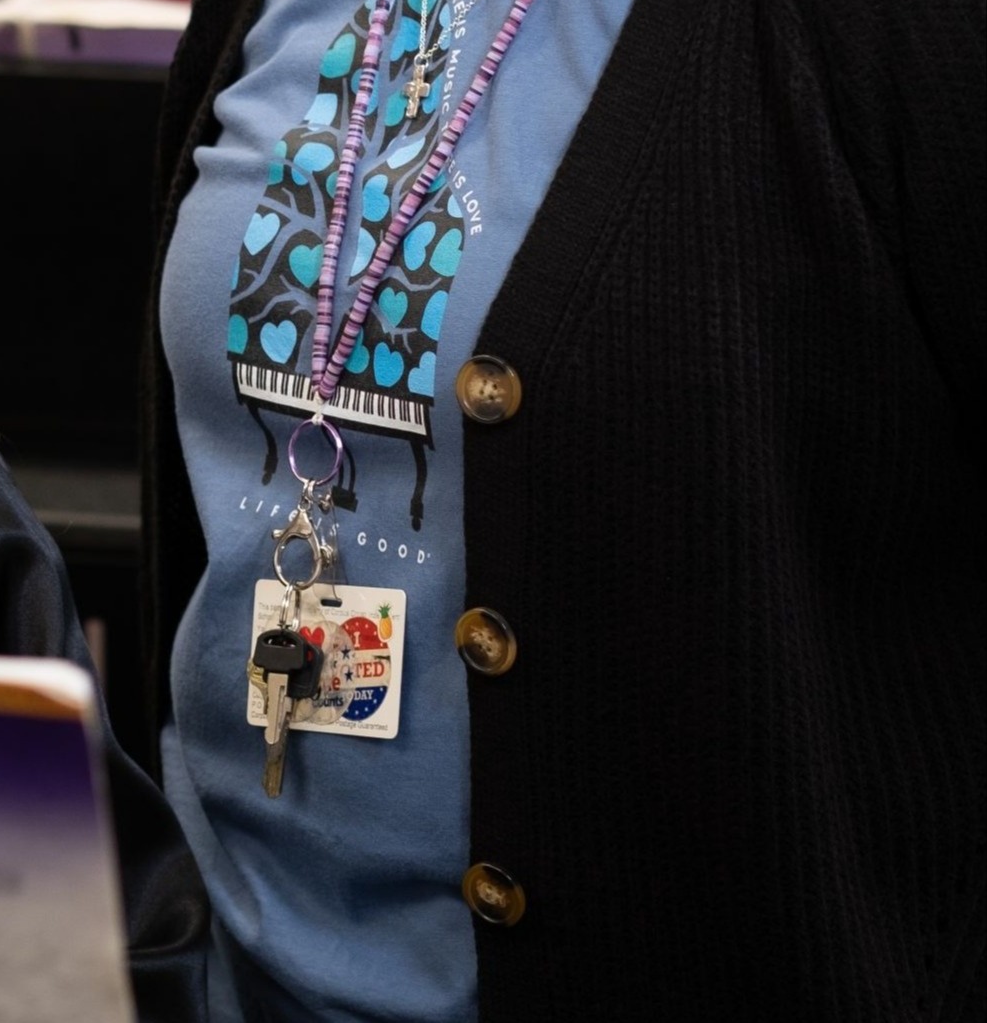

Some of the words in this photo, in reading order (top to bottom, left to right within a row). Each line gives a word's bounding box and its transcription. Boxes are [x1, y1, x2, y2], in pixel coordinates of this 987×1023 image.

[440, 48, 462, 117] MUSIC
[462, 190, 483, 236] LOVE
[357, 531, 426, 565] GOOD
[353, 631, 361, 648] I
